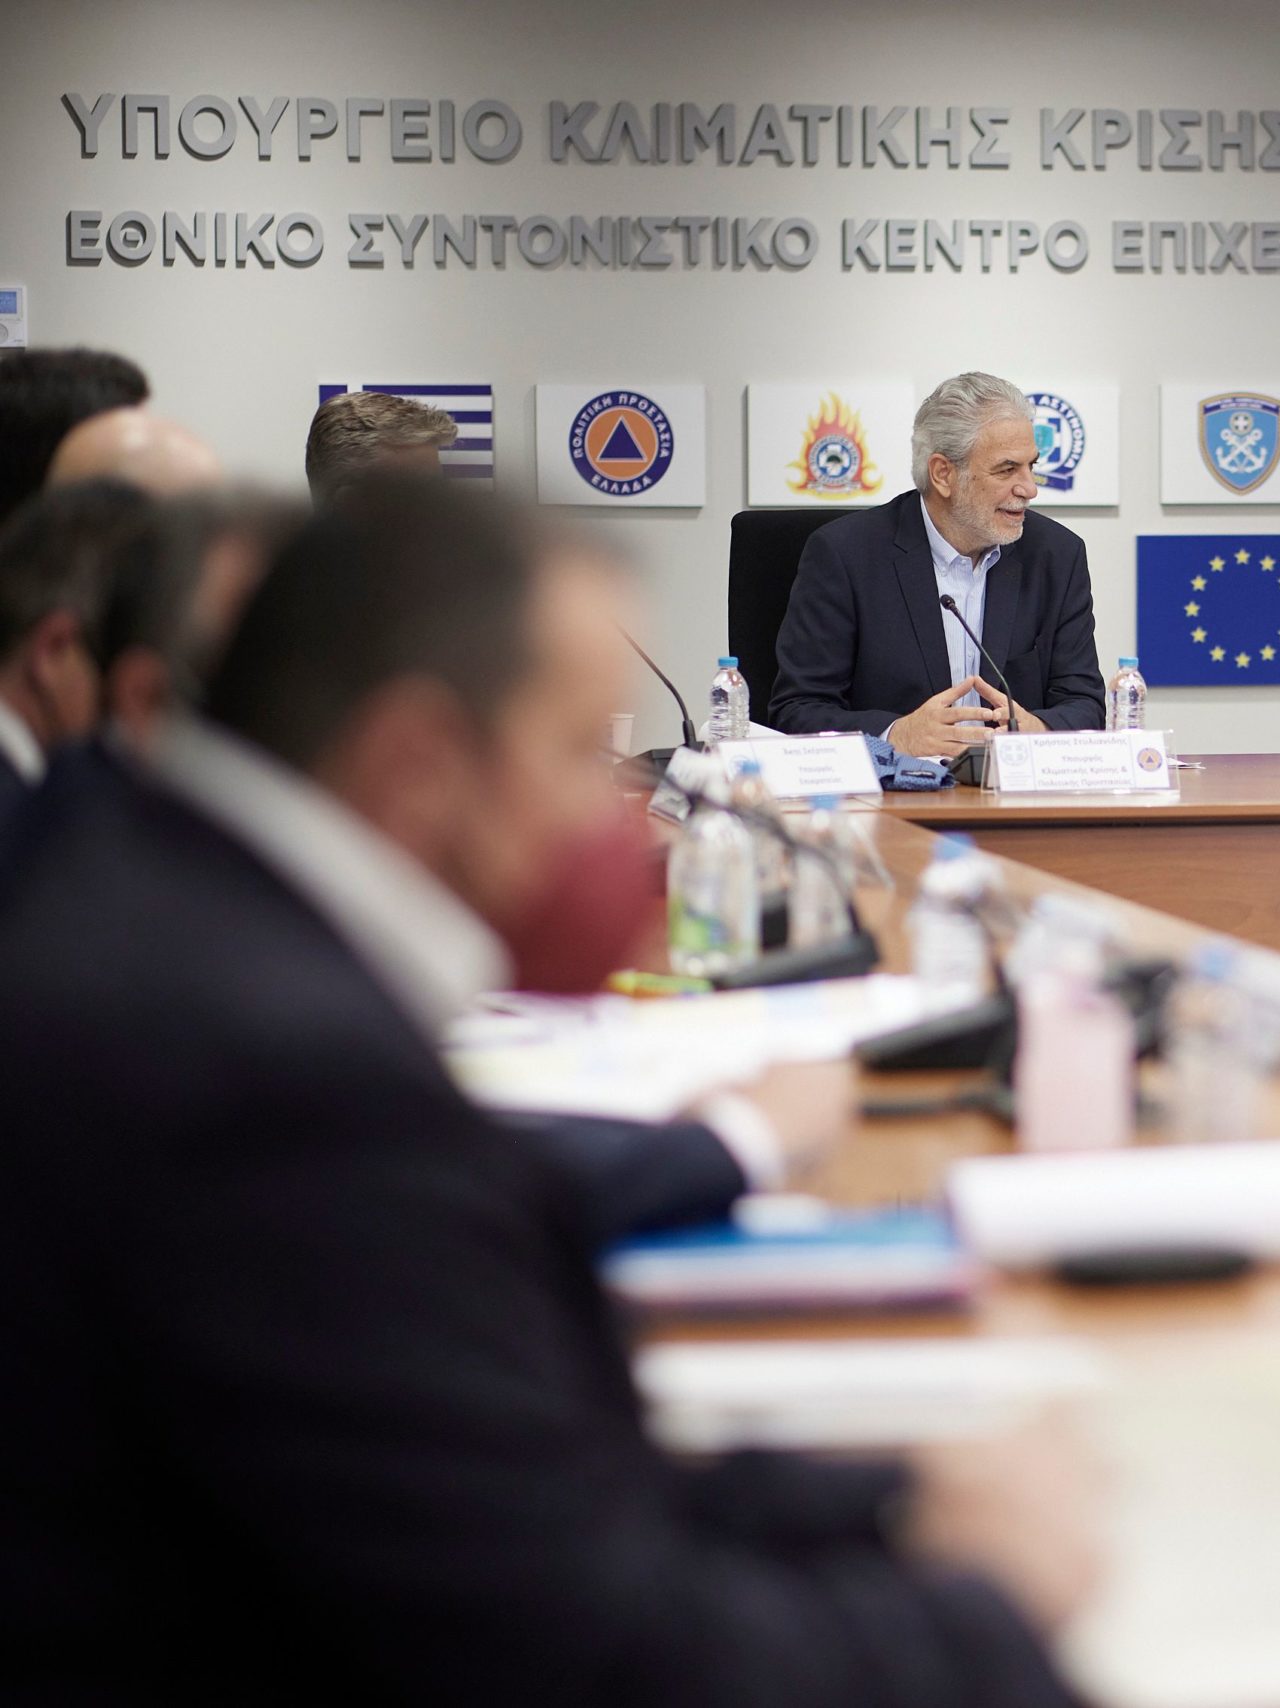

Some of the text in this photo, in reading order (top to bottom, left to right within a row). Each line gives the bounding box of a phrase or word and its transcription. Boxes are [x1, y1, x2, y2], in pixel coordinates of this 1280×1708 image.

[61, 93, 522, 163] ΥΠΟΥΡΓΕΙΟ
[549, 100, 1012, 169] ΚΛΙΜΑΤΙΚΗΣ
[66, 210, 324, 268] ΕΘΝΙΚΟ
[347, 212, 820, 272] ΣΥΝΤΟΝΙΣΤΙΚΟ
[841, 217, 1089, 273] ΚΕΝΤΡΟ
[572, 393, 671, 459] ΠΟΛΙΤΙΚΗ ΠΡΟΣΤΑΣΙΑ
[591, 474, 653, 494] ΕΛΛΑΔΑ
